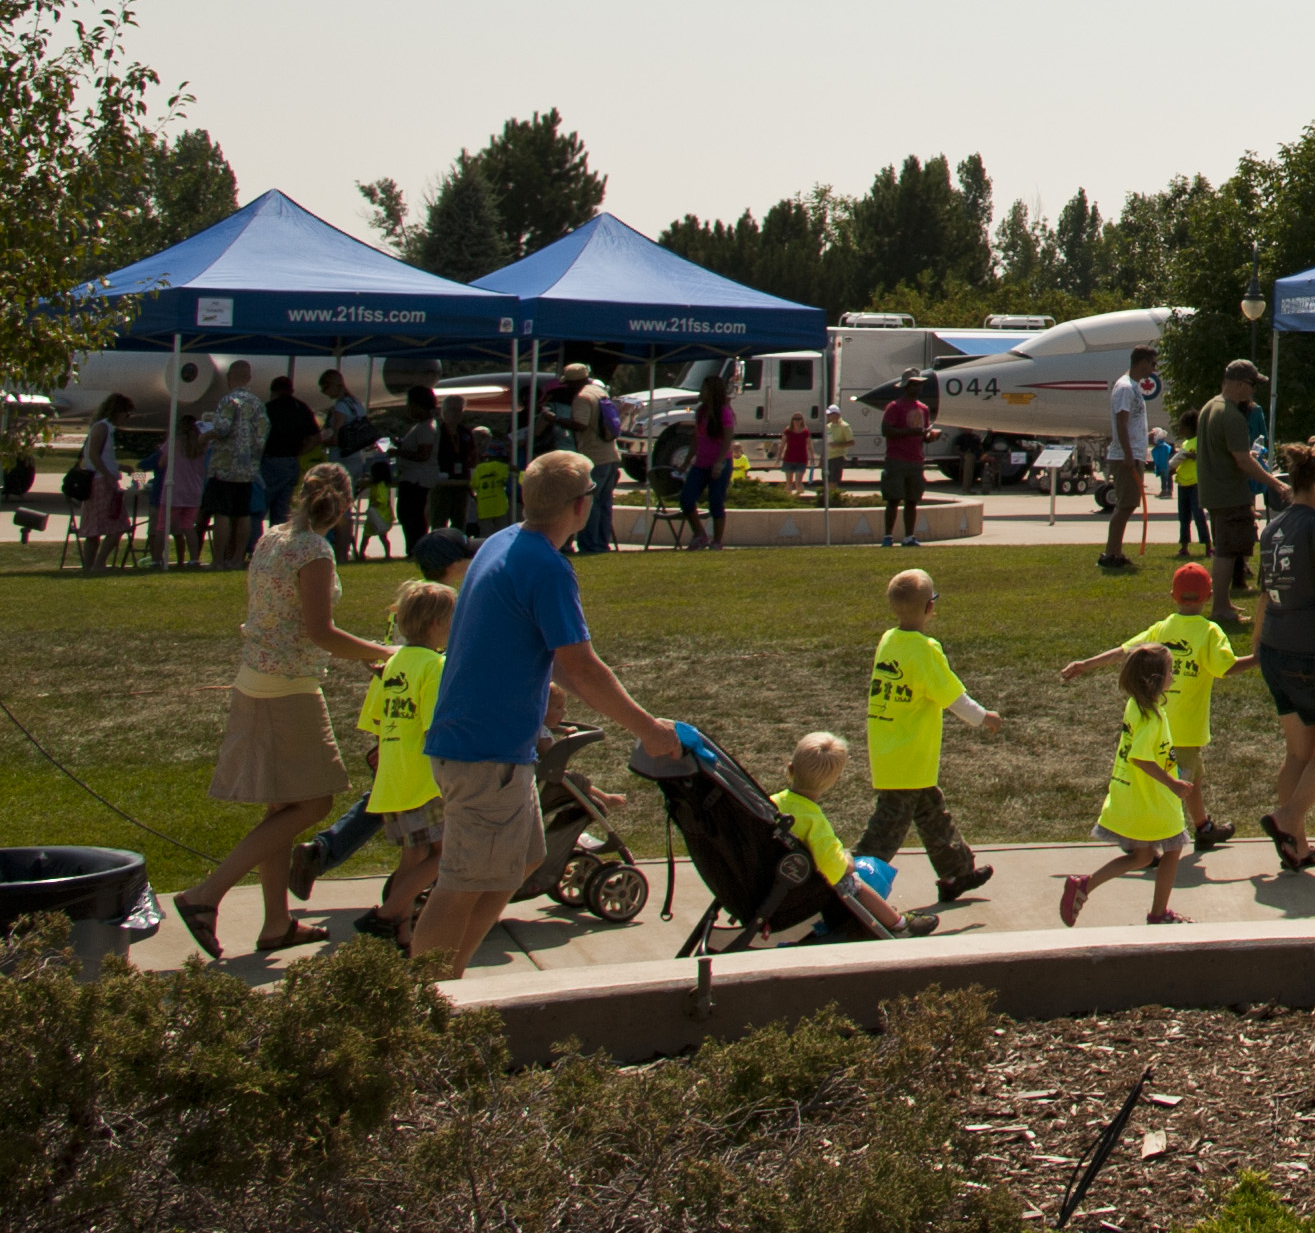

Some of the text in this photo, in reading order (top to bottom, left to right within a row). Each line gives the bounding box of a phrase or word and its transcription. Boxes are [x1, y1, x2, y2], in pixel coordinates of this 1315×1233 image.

[288, 305, 427, 323] www.21fss.com
[629, 318, 746, 334] www.21fss.com
[946, 377, 1000, 396] 044
